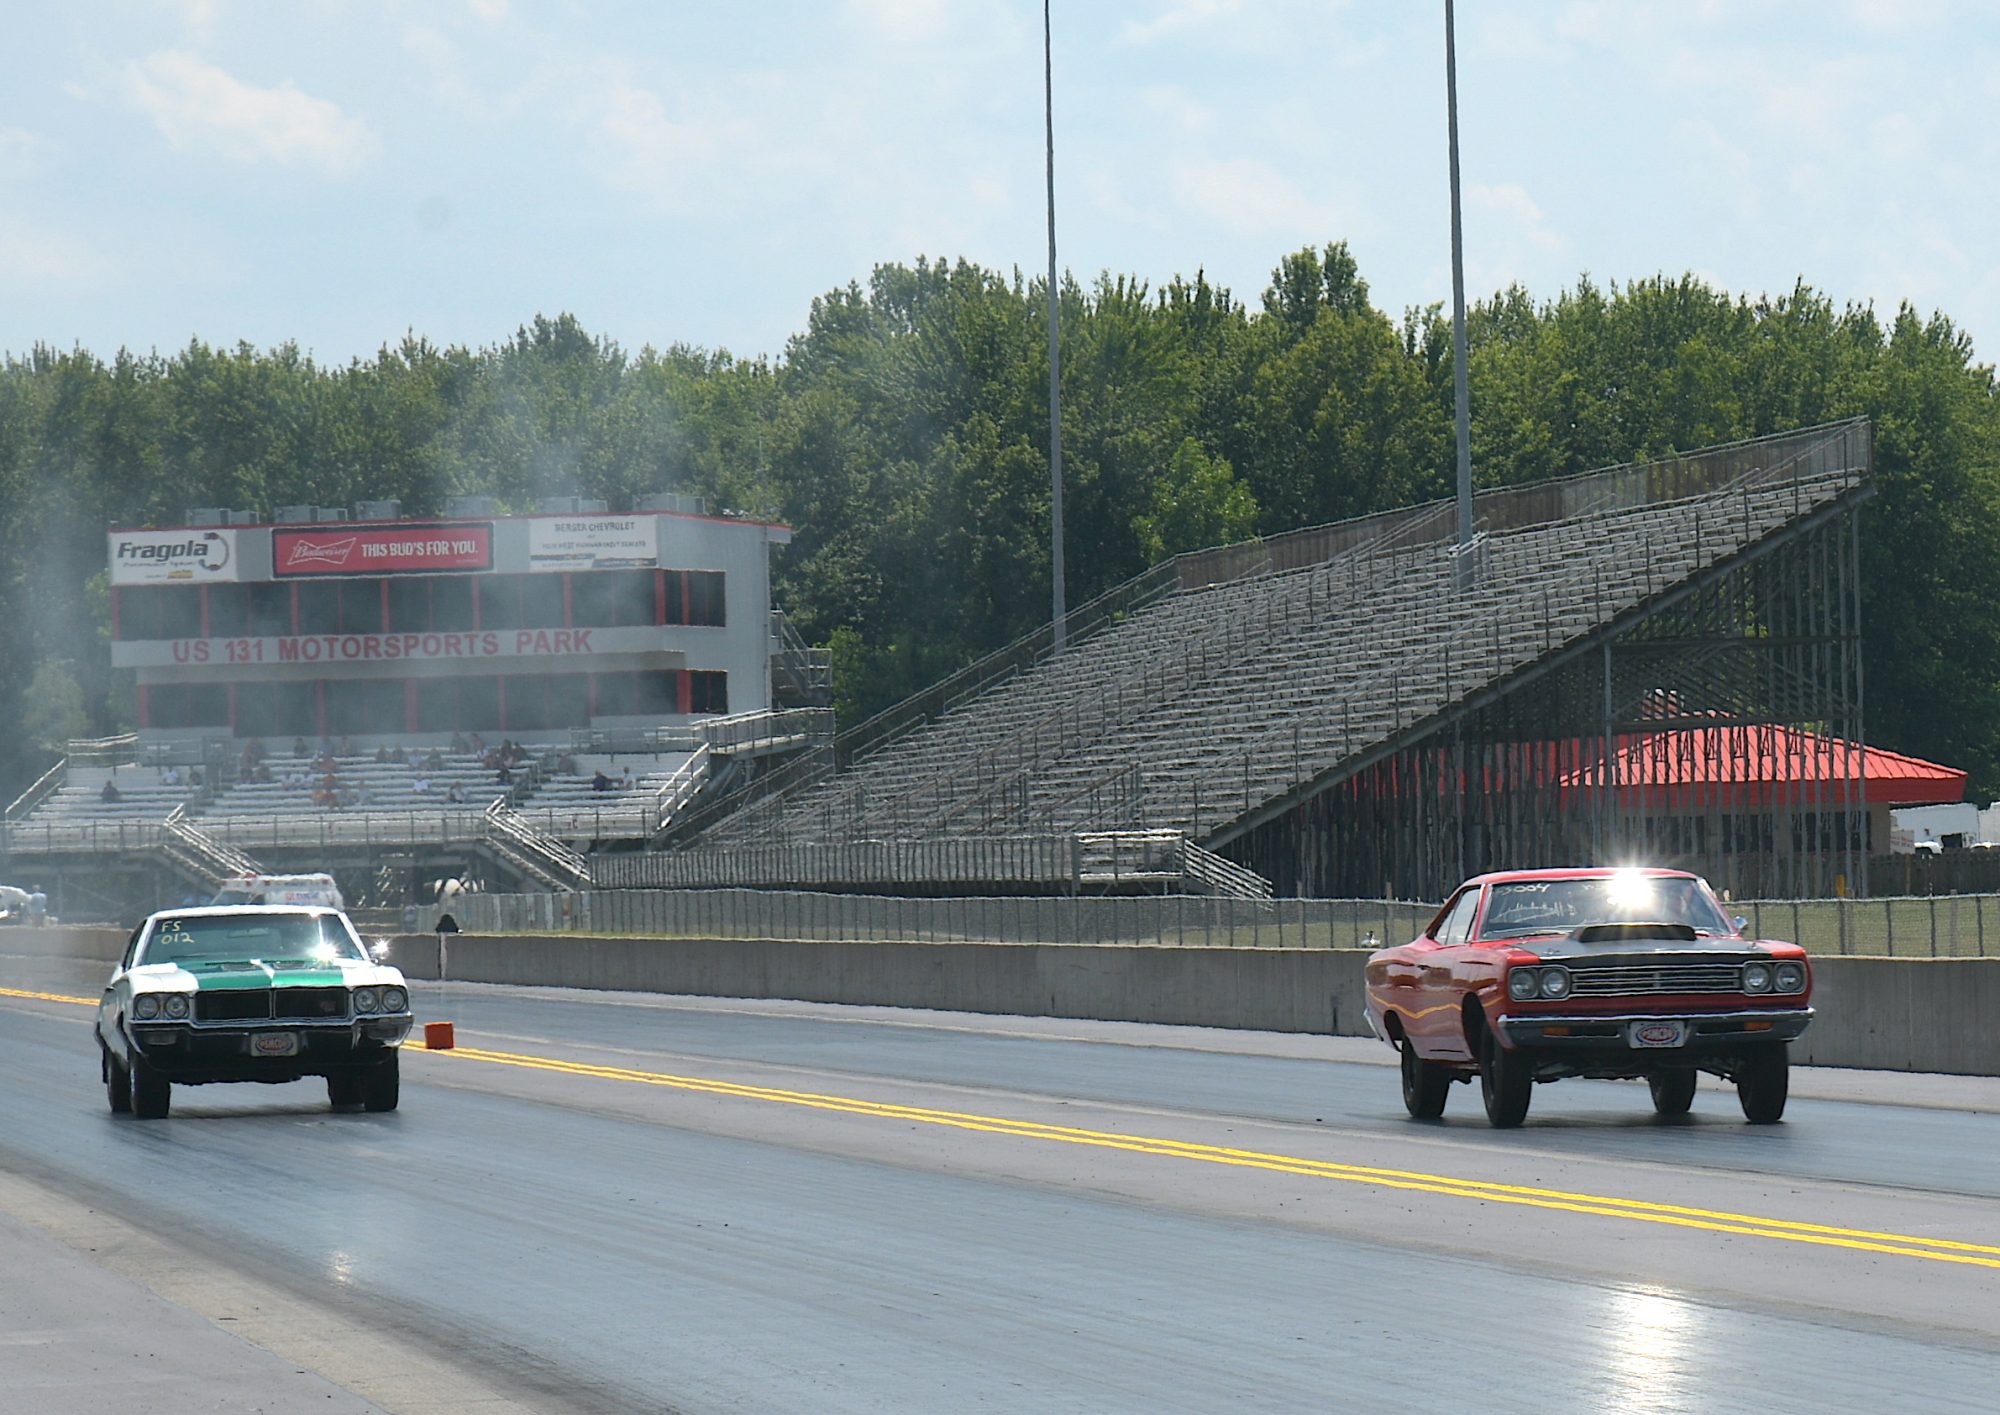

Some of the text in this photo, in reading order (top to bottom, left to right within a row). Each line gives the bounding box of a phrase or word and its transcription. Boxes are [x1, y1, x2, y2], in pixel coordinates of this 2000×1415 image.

[588, 521, 635, 532] CHEVROLET
[117, 540, 208, 562] Fragola
[294, 542, 349, 559] Budweiser
[362, 543, 388, 558] THIS
[390, 541, 425, 557] BUD'S
[426, 540, 449, 556] FOR
[172, 629, 593, 663] US 131 MOTORSPORTS PARK
[161, 920, 182, 933] FS
[161, 932, 195, 945] 012
